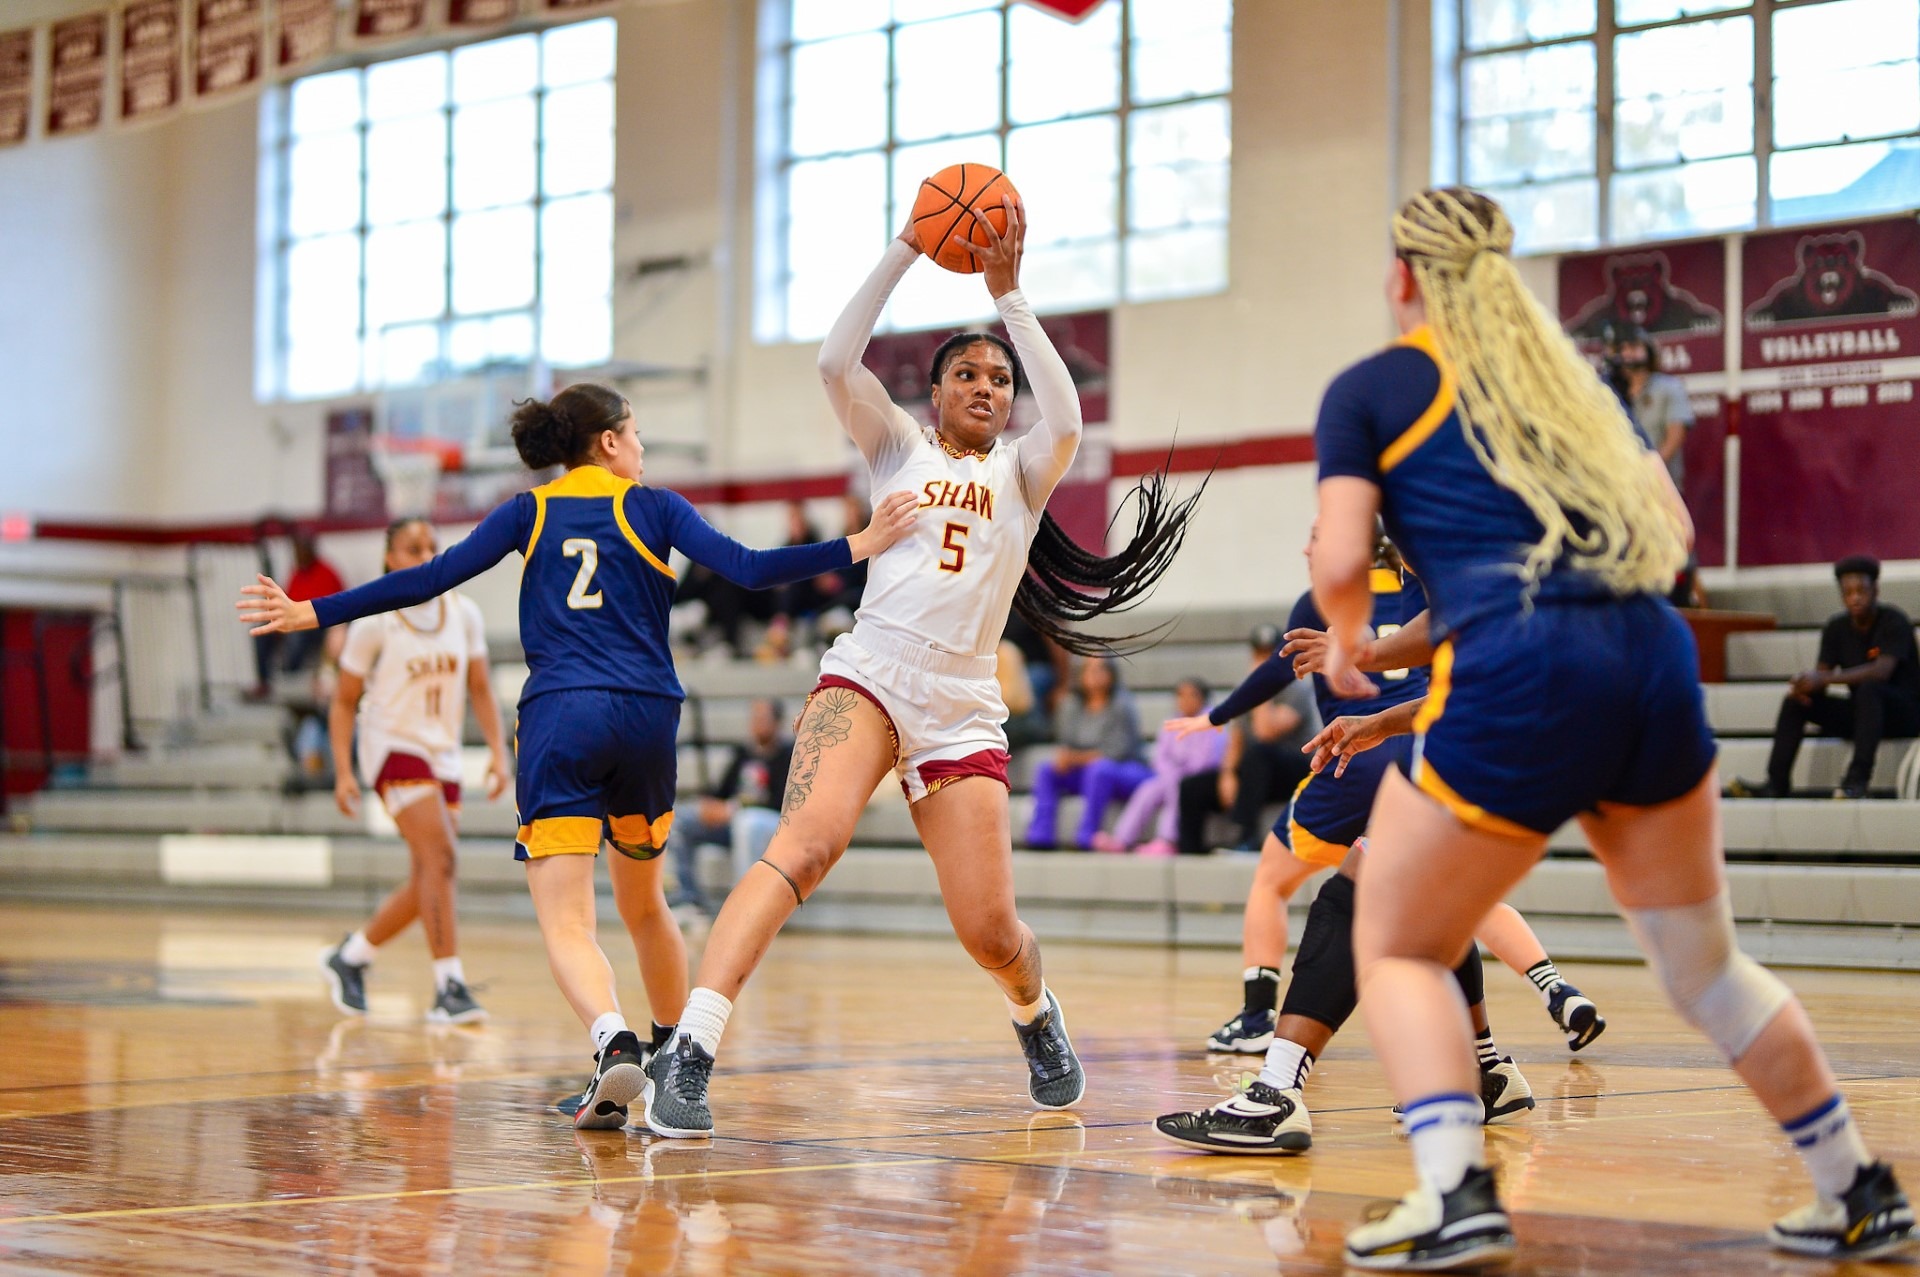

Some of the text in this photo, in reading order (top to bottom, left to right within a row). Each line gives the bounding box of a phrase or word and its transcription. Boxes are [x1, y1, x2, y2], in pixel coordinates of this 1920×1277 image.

[1761, 327, 1900, 362] VOLLEYBALL
[918, 480, 994, 522] SHAW
[938, 520, 969, 574] 5
[562, 538, 603, 609] 2
[405, 653, 460, 679] SHAW
[425, 685, 442, 718] 11
